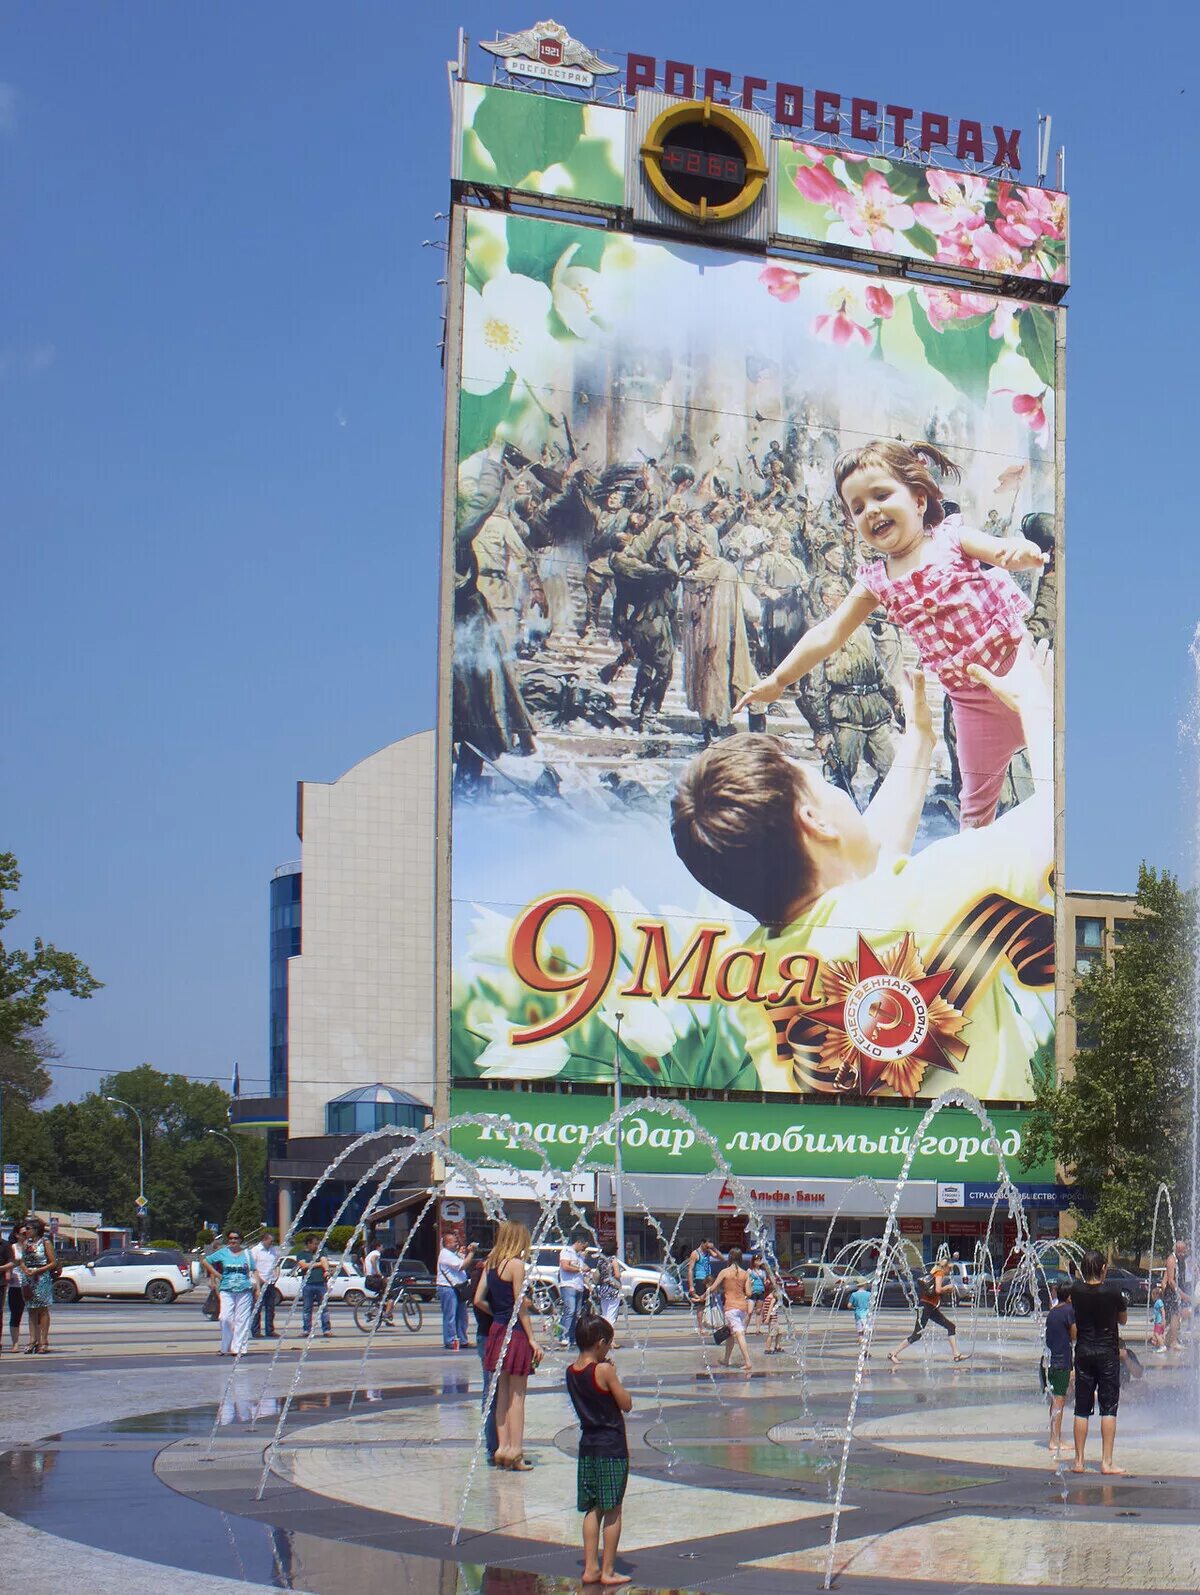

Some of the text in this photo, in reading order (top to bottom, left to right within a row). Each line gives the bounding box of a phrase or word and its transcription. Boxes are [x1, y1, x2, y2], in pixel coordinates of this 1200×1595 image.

[512, 61, 589, 83] РОСГОССТРАХ
[541, 45, 560, 57] 1921
[626, 52, 1022, 171] РОСГОССТРАХ
[511, 893, 827, 1046] 9 Мая
[848, 978, 911, 1056] ОТЕЧЕСТВЕННАЯ
[477, 1113, 1021, 1163] Краснодар любимый город
